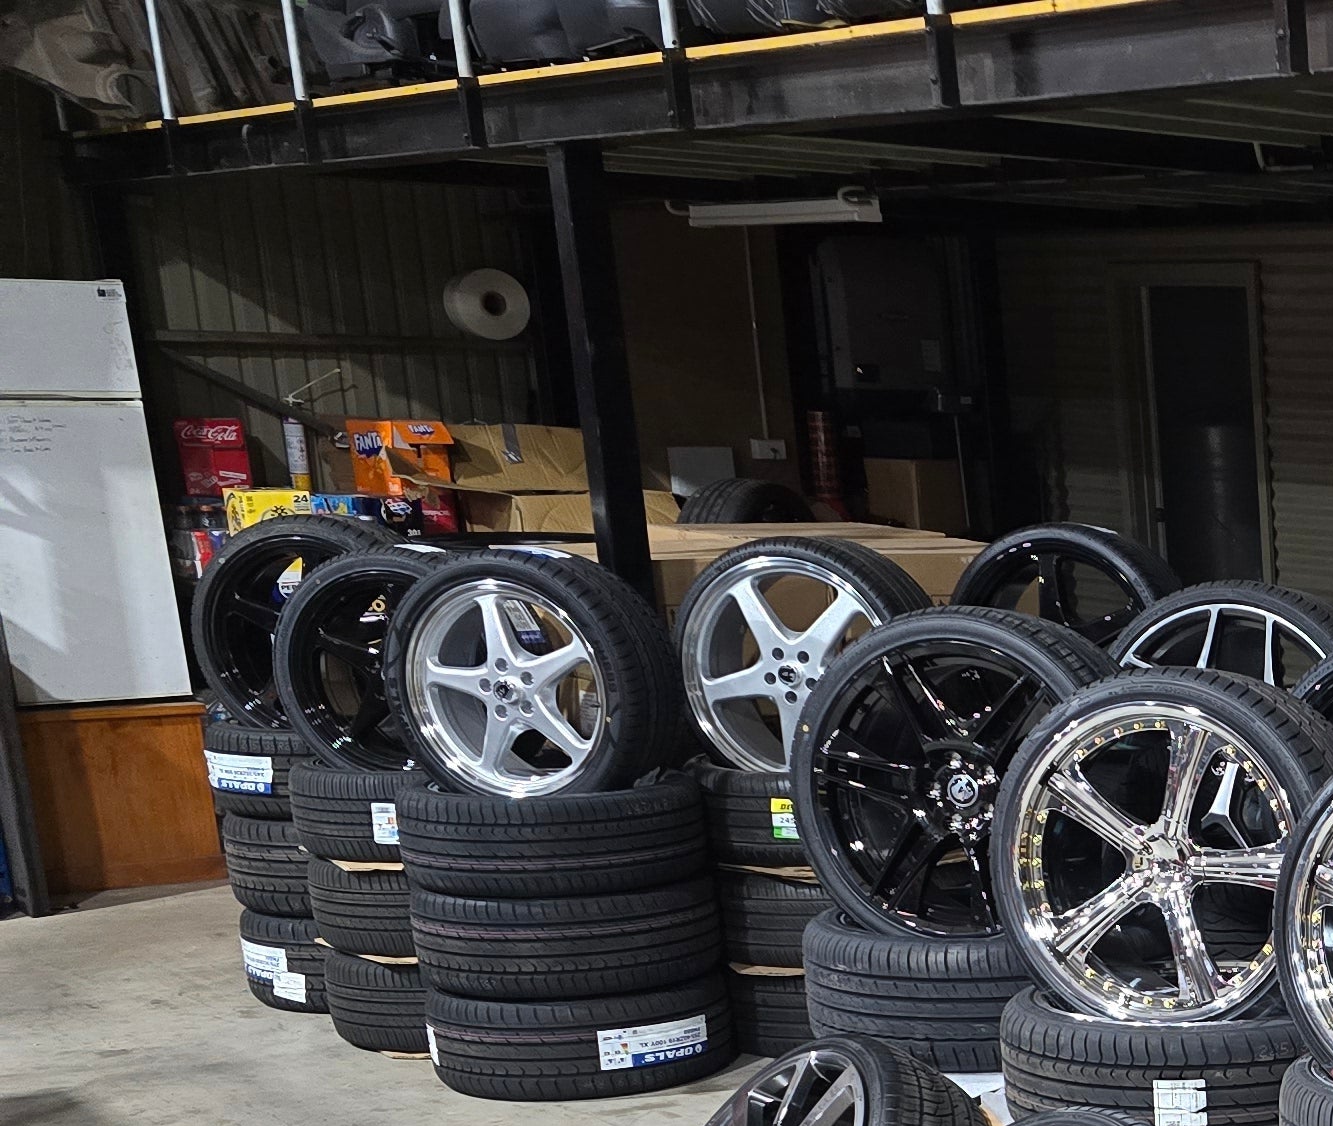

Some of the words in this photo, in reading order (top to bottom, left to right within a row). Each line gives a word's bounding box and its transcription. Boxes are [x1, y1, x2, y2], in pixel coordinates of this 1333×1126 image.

[407, 424, 435, 433] FANTA
[353, 432, 383, 450] FANTA
[294, 495, 308, 503] 24
[651, 1039, 667, 1047] 100Y
[644, 1047, 693, 1062] OPALS
